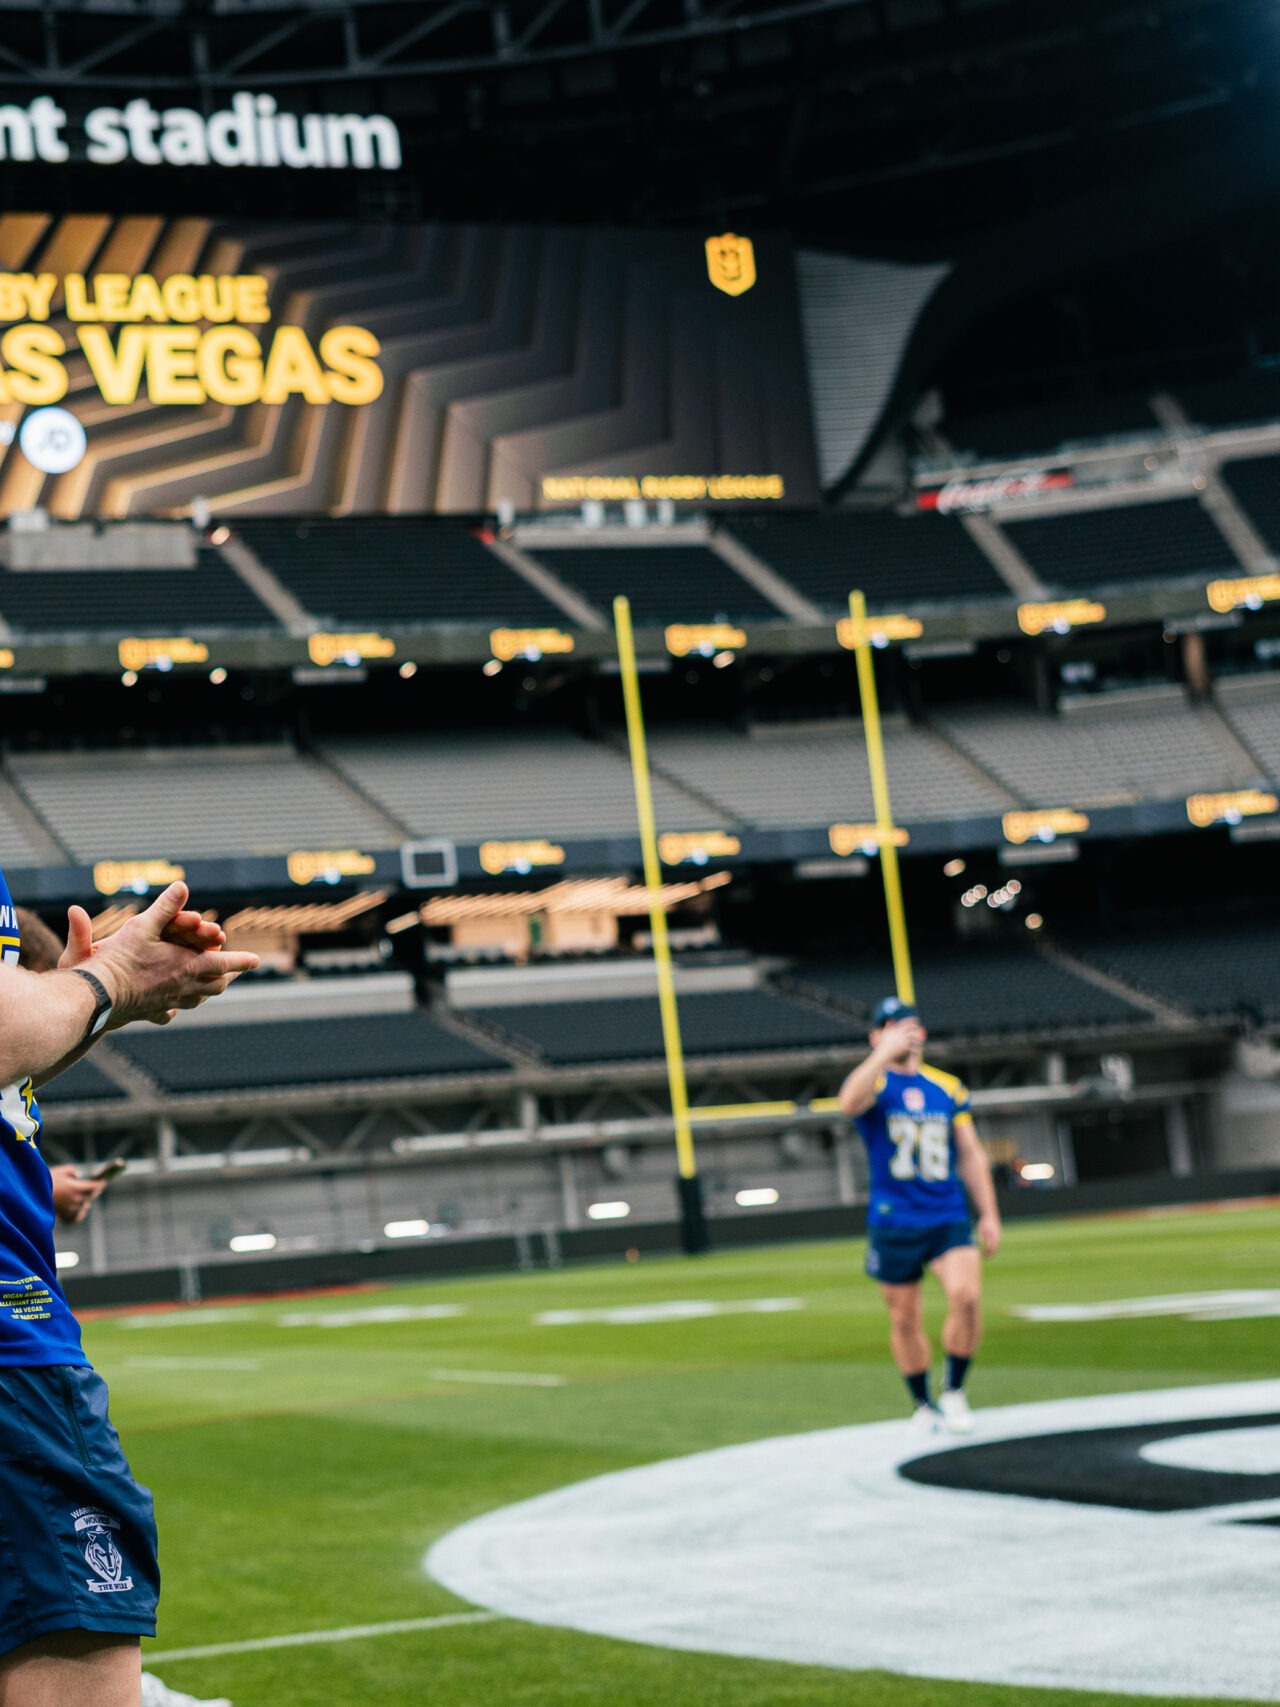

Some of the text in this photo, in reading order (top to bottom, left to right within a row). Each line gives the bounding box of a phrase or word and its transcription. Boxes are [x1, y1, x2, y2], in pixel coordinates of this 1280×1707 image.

[85, 92, 402, 170] stadium
[65, 274, 271, 323] LEAGUE
[76, 325, 385, 406] VEGAS
